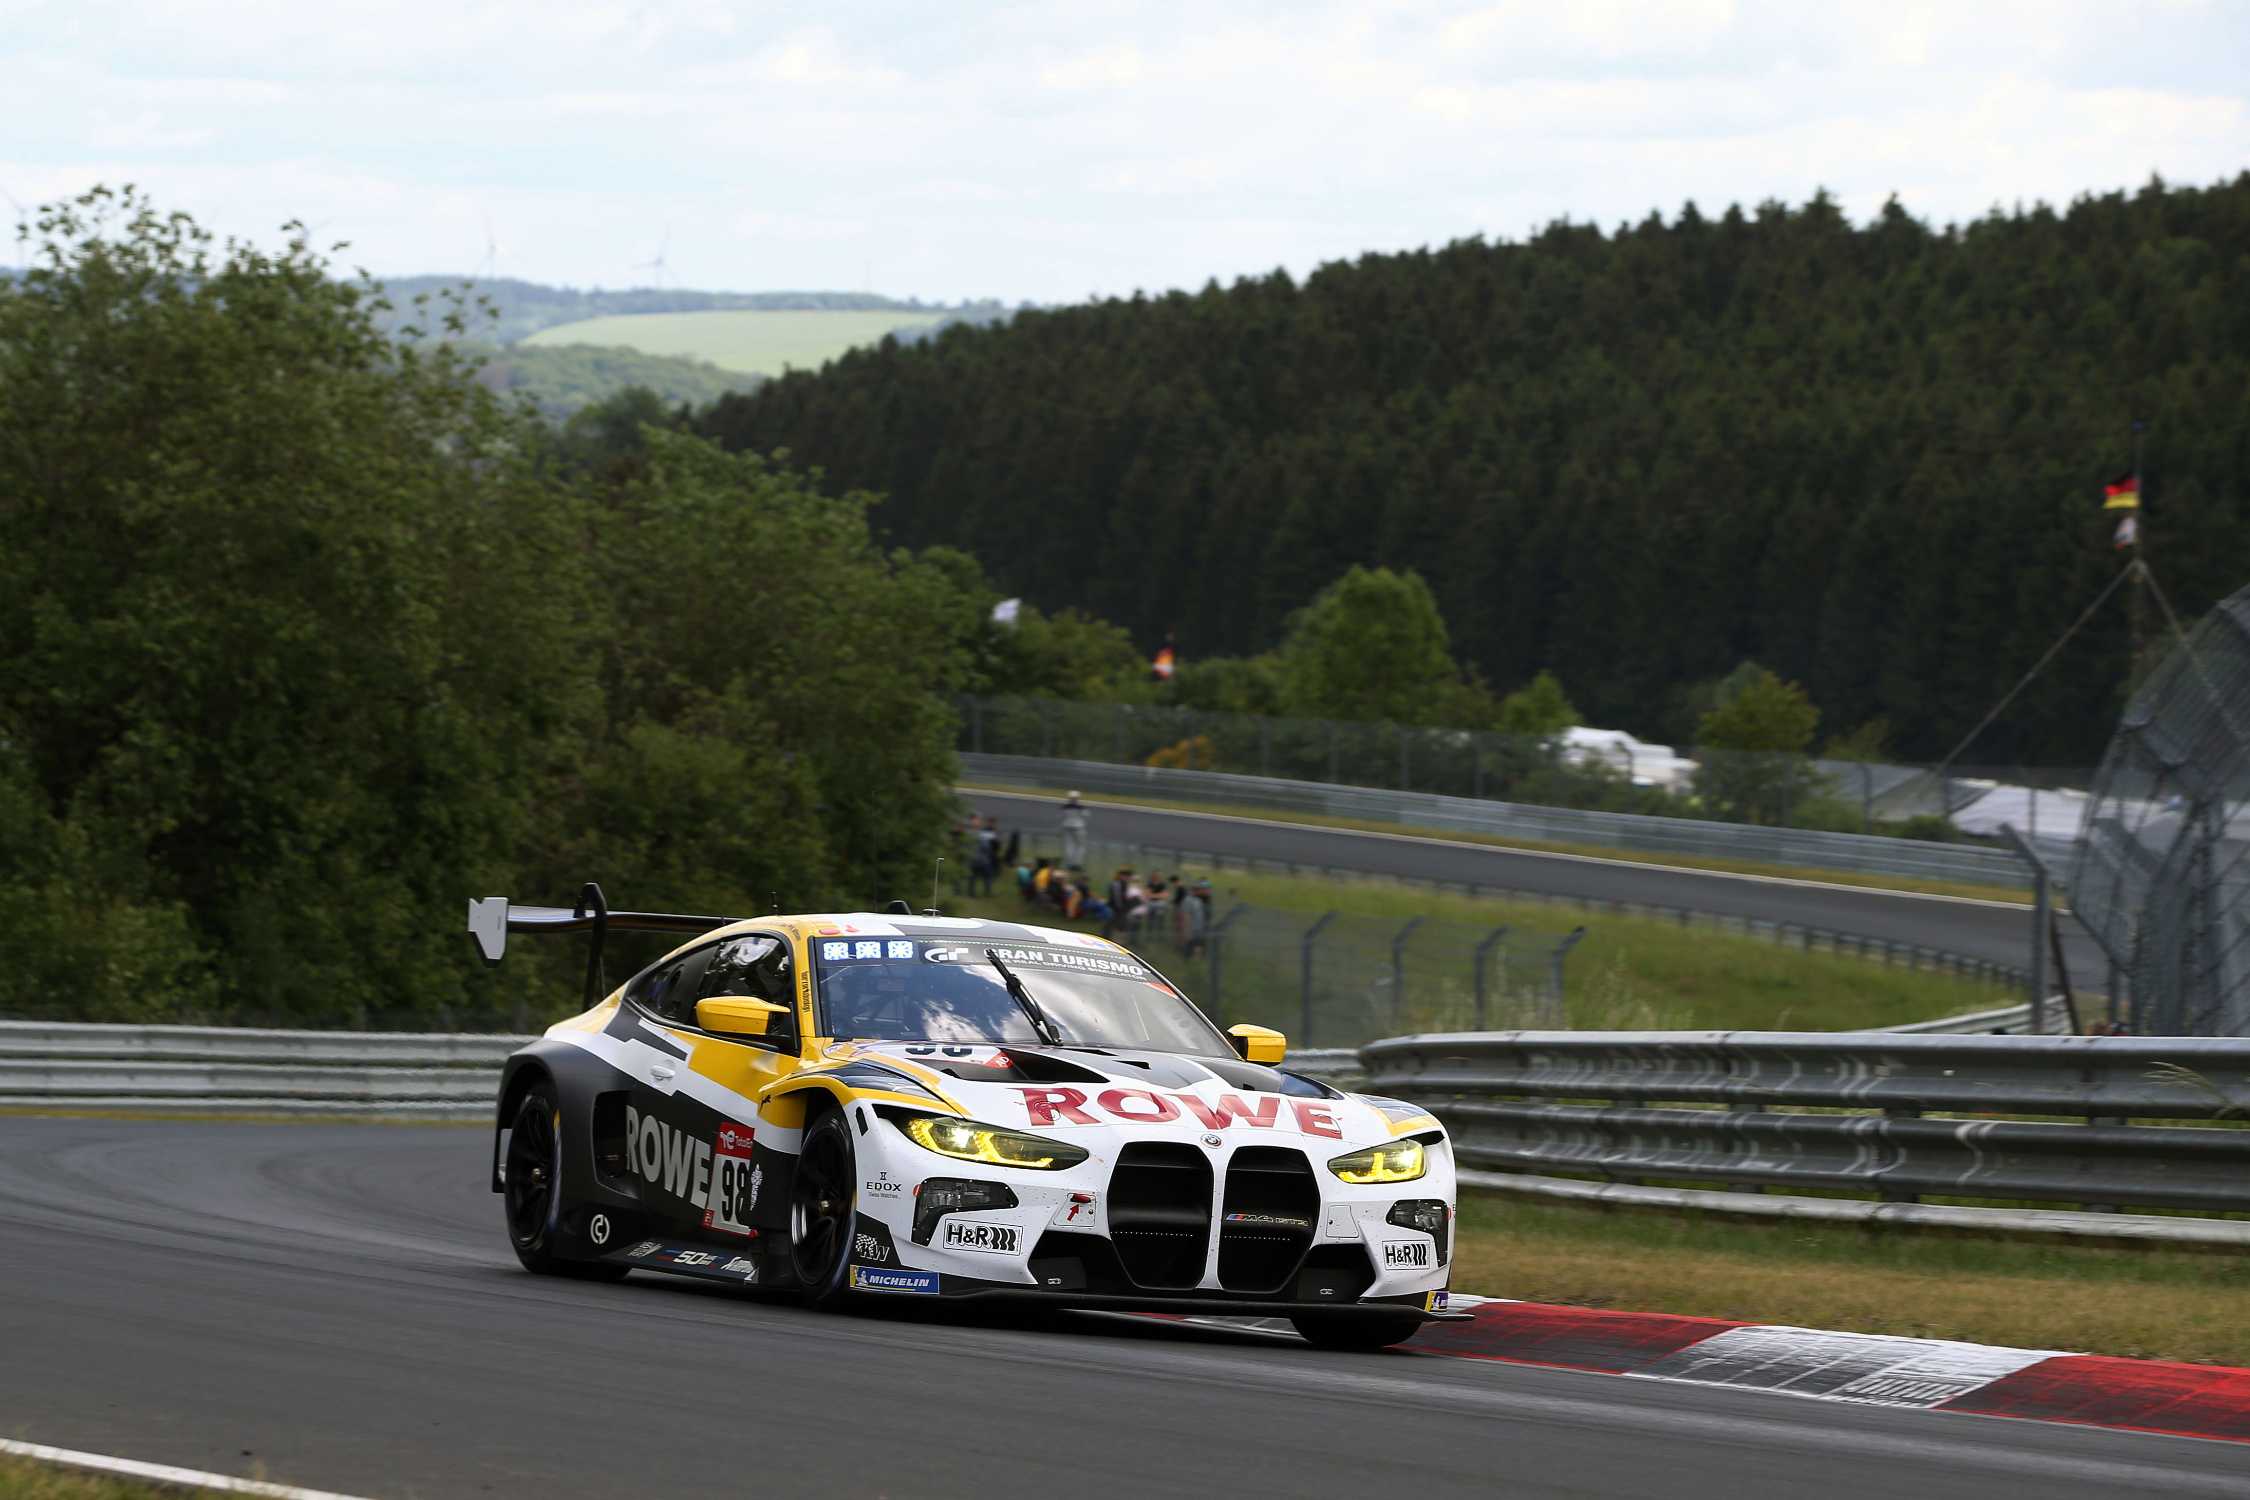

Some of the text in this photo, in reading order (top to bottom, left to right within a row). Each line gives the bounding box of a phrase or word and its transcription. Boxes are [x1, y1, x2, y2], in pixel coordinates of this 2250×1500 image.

[1048, 953, 1145, 976] TURISMO
[1006, 1087, 1343, 1140] ROWE
[626, 1105, 711, 1209] ROWE
[722, 1159, 751, 1225] 98
[866, 1181, 902, 1192] EDOX
[946, 1222, 990, 1248] H&R
[1385, 1243, 1412, 1265] H&R
[869, 1275, 930, 1287] MICHELIN
